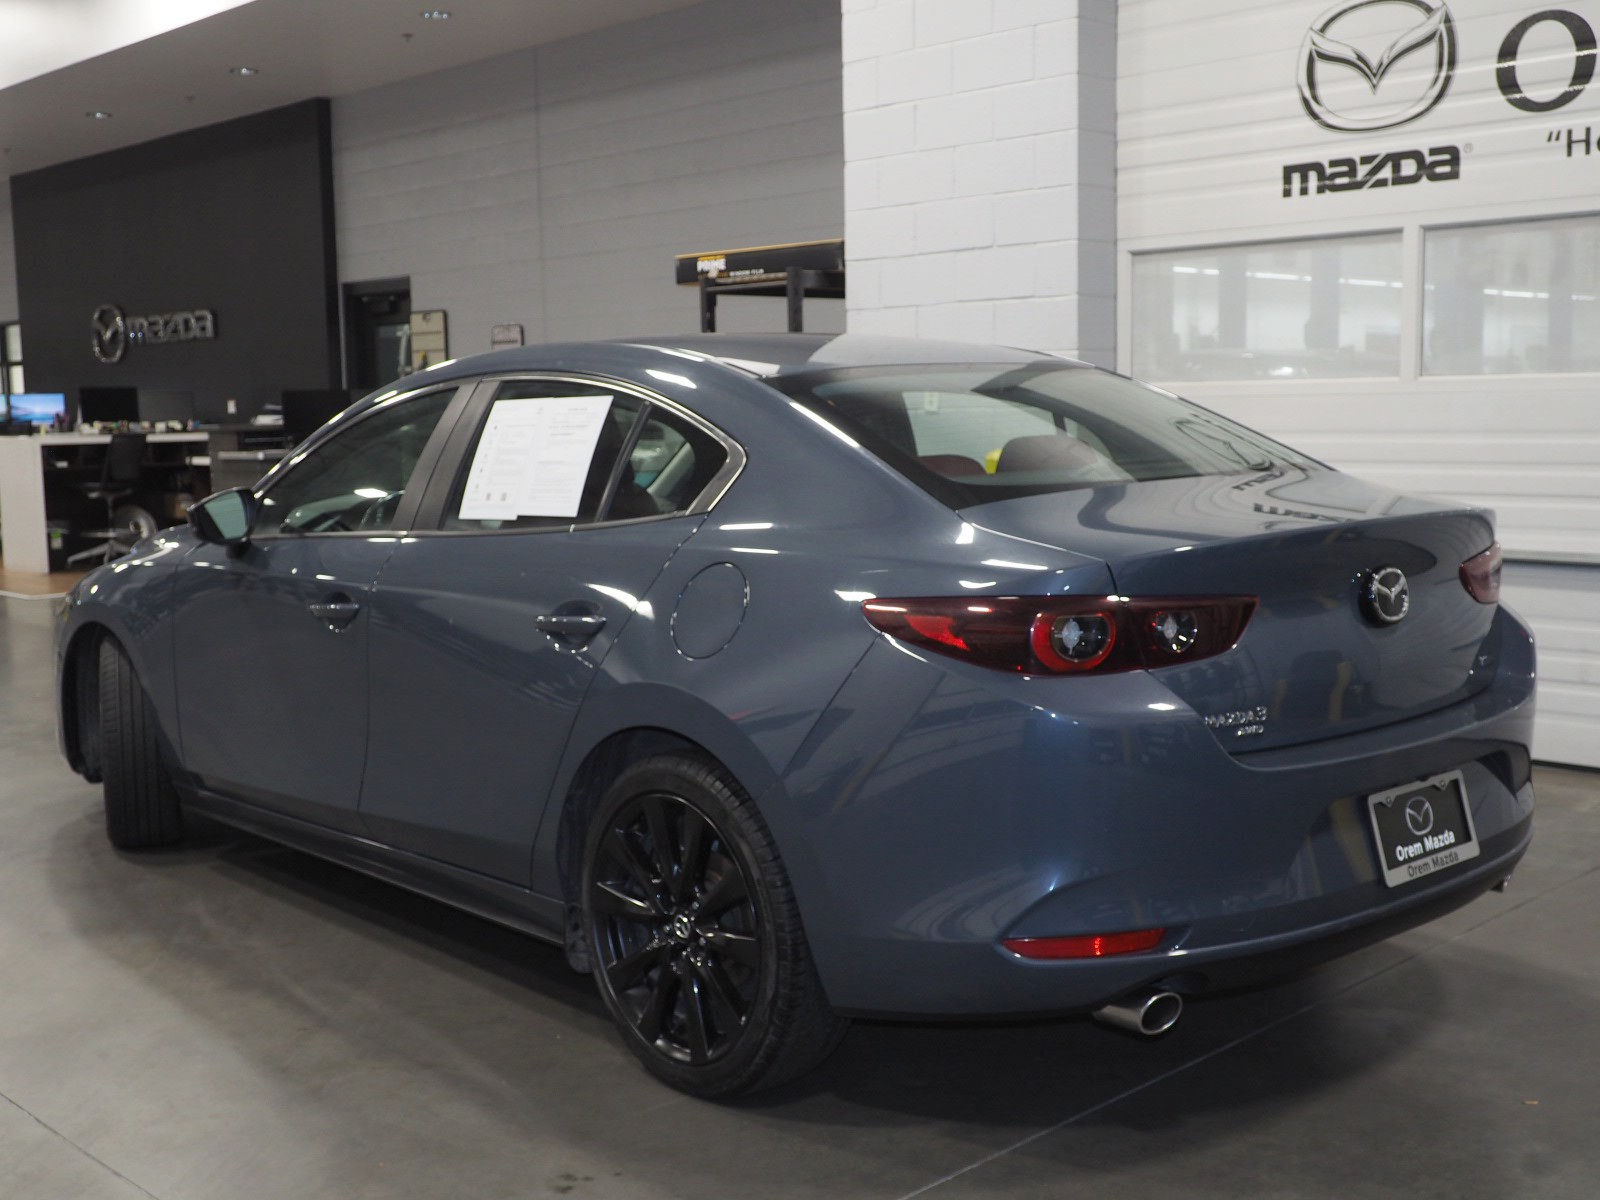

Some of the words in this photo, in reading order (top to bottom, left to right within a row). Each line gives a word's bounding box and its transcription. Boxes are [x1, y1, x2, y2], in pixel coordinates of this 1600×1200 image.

[1547, 126, 1600, 157] “H
[1396, 842, 1423, 861] Orem
[1424, 830, 1455, 851] Mazda
[1408, 862, 1430, 876] Orem
[1432, 852, 1458, 868] Mazda
